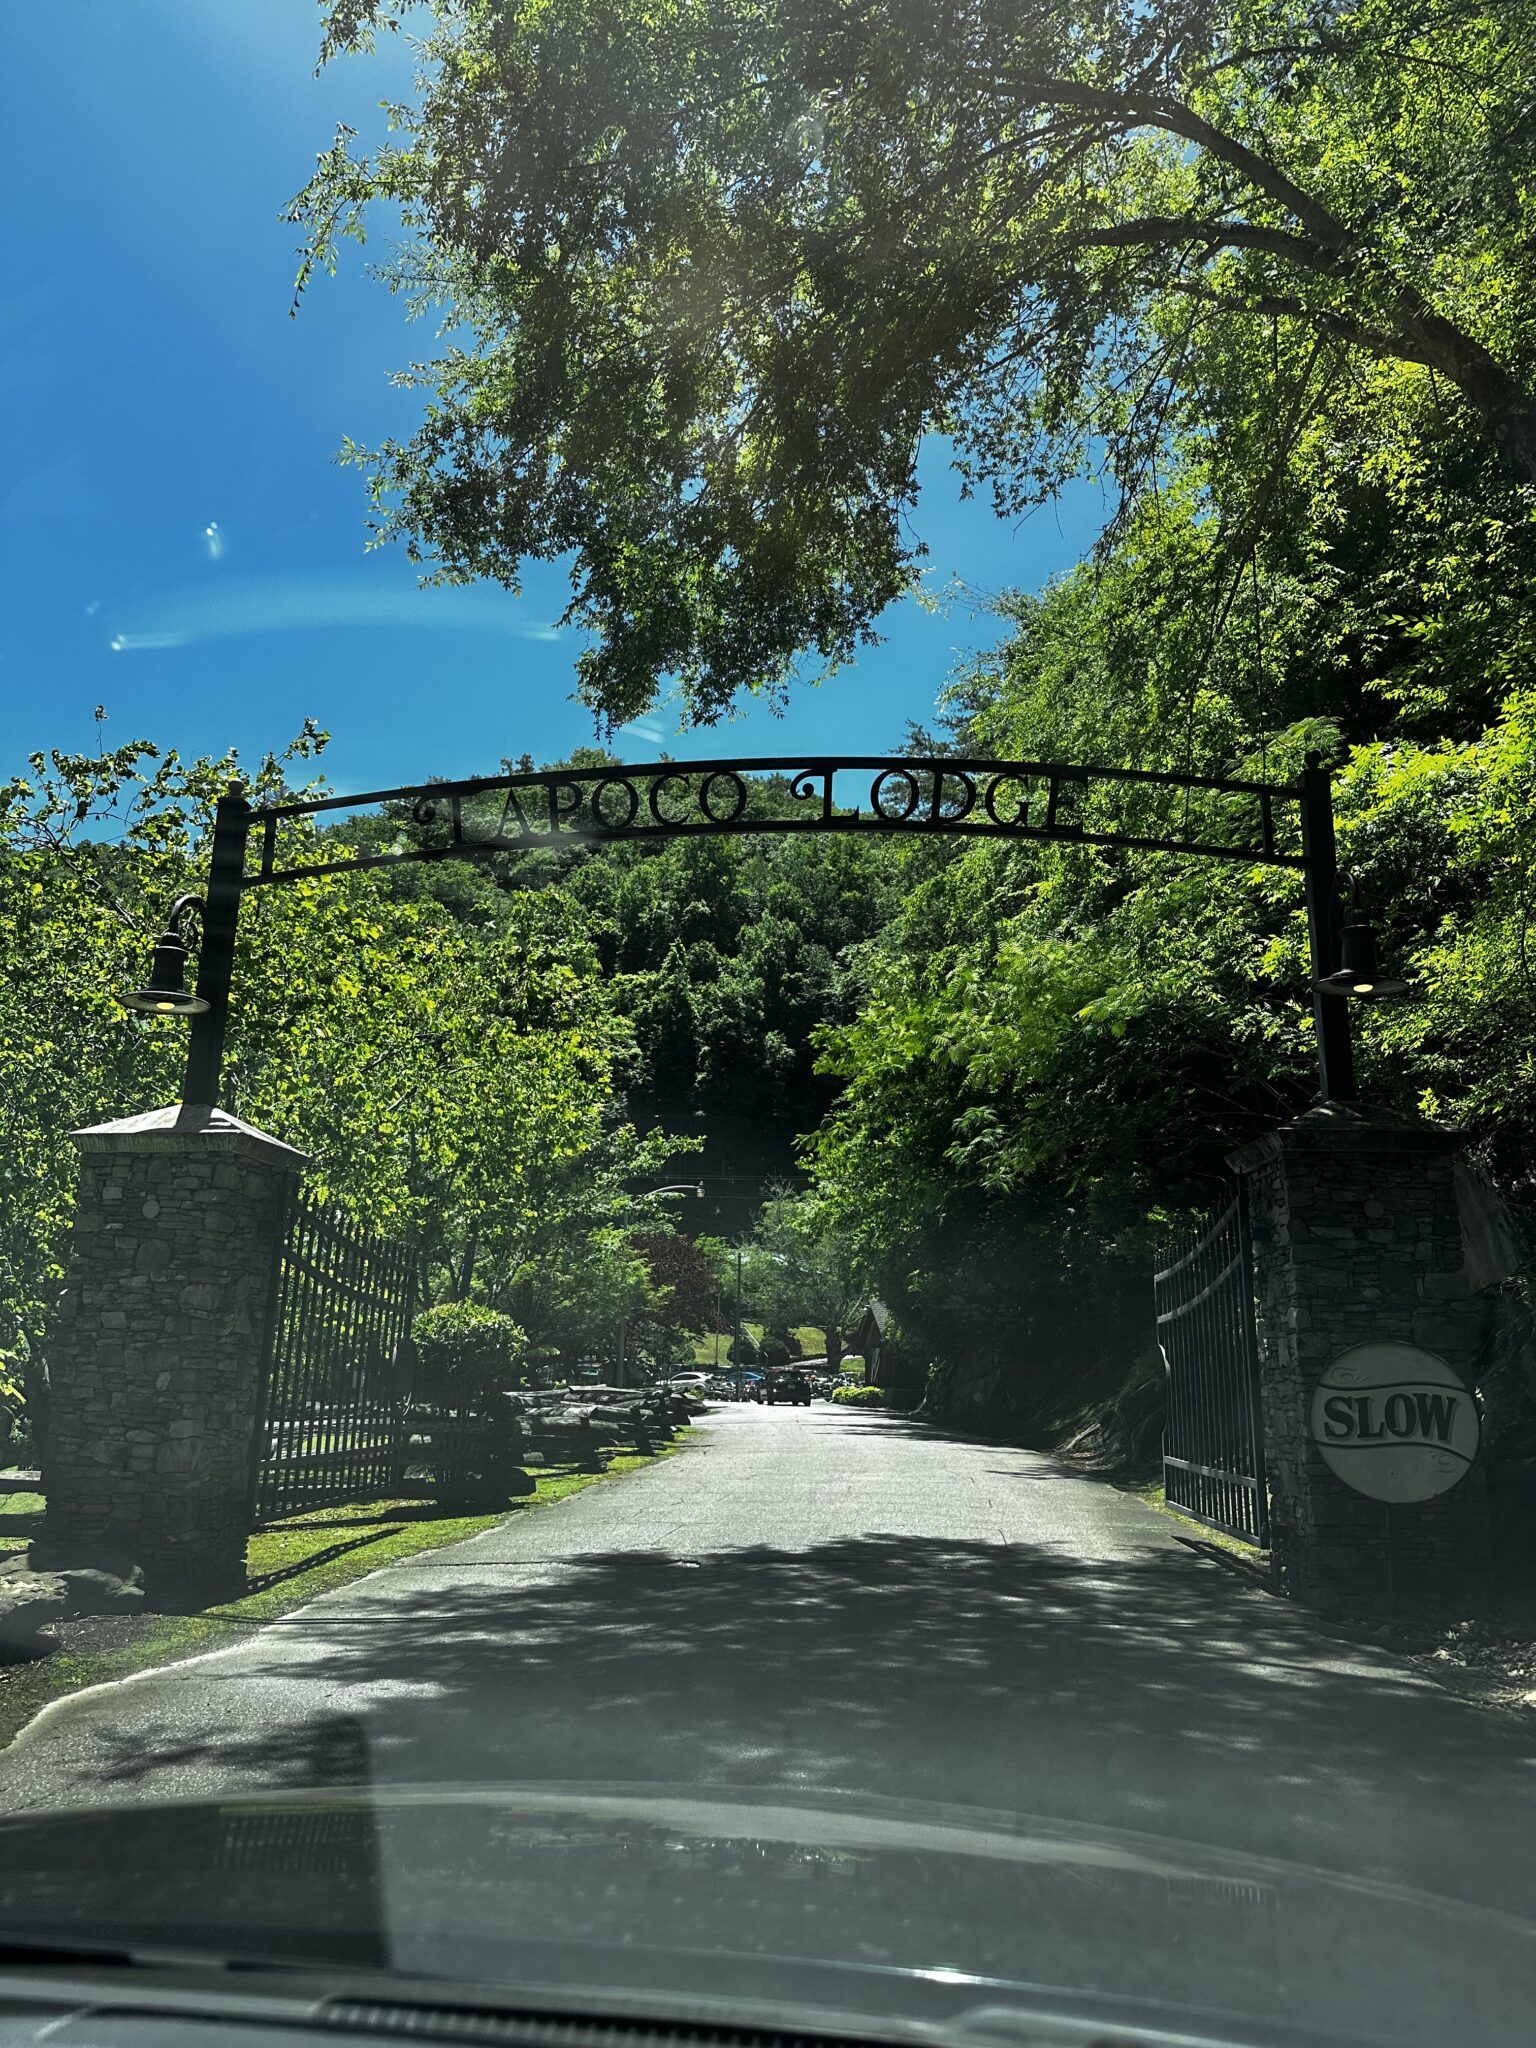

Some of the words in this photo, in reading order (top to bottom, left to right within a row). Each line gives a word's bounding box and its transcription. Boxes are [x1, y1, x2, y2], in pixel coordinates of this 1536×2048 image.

[413, 772, 748, 843] TAPOCO
[791, 768, 1087, 828] LODGE
[1324, 1393, 1458, 1442] SLOW
